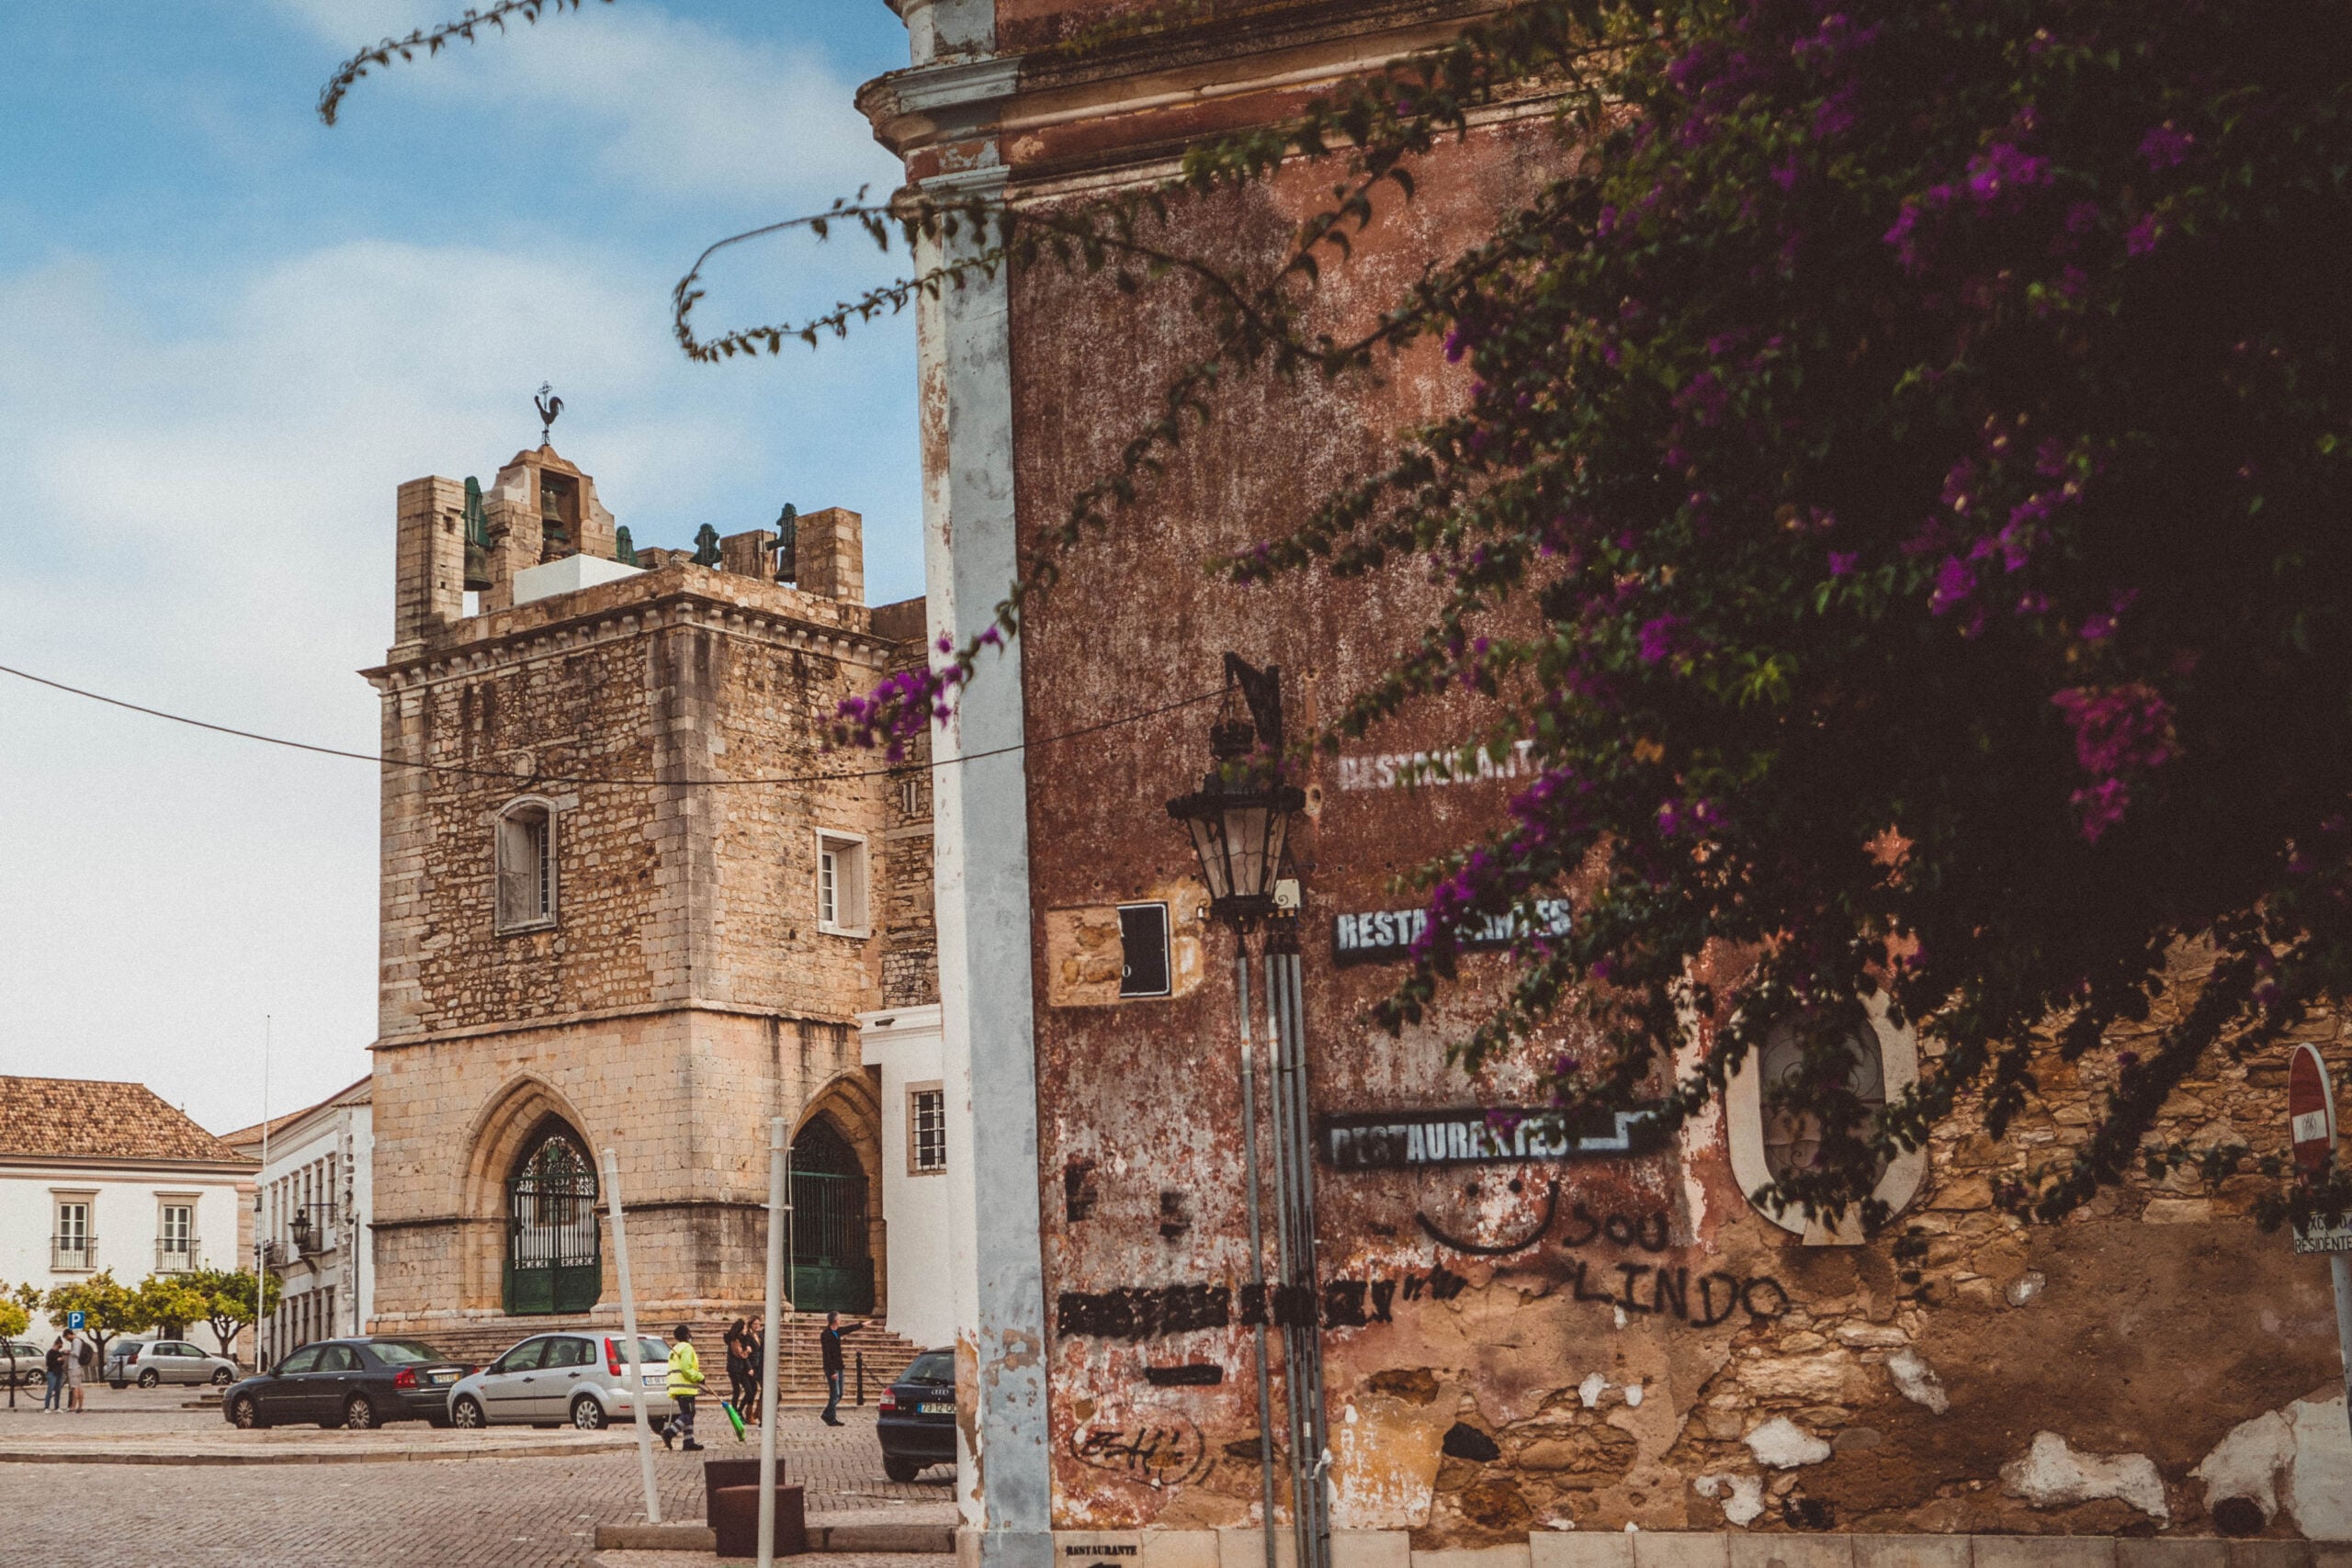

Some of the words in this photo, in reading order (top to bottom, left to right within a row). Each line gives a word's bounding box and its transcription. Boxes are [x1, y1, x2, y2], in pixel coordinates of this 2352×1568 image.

[1574, 1261, 1792, 1329] LINDO
[72, 1313, 82, 1328] P
[1066, 1545, 1137, 1556] RESTAURANTE
